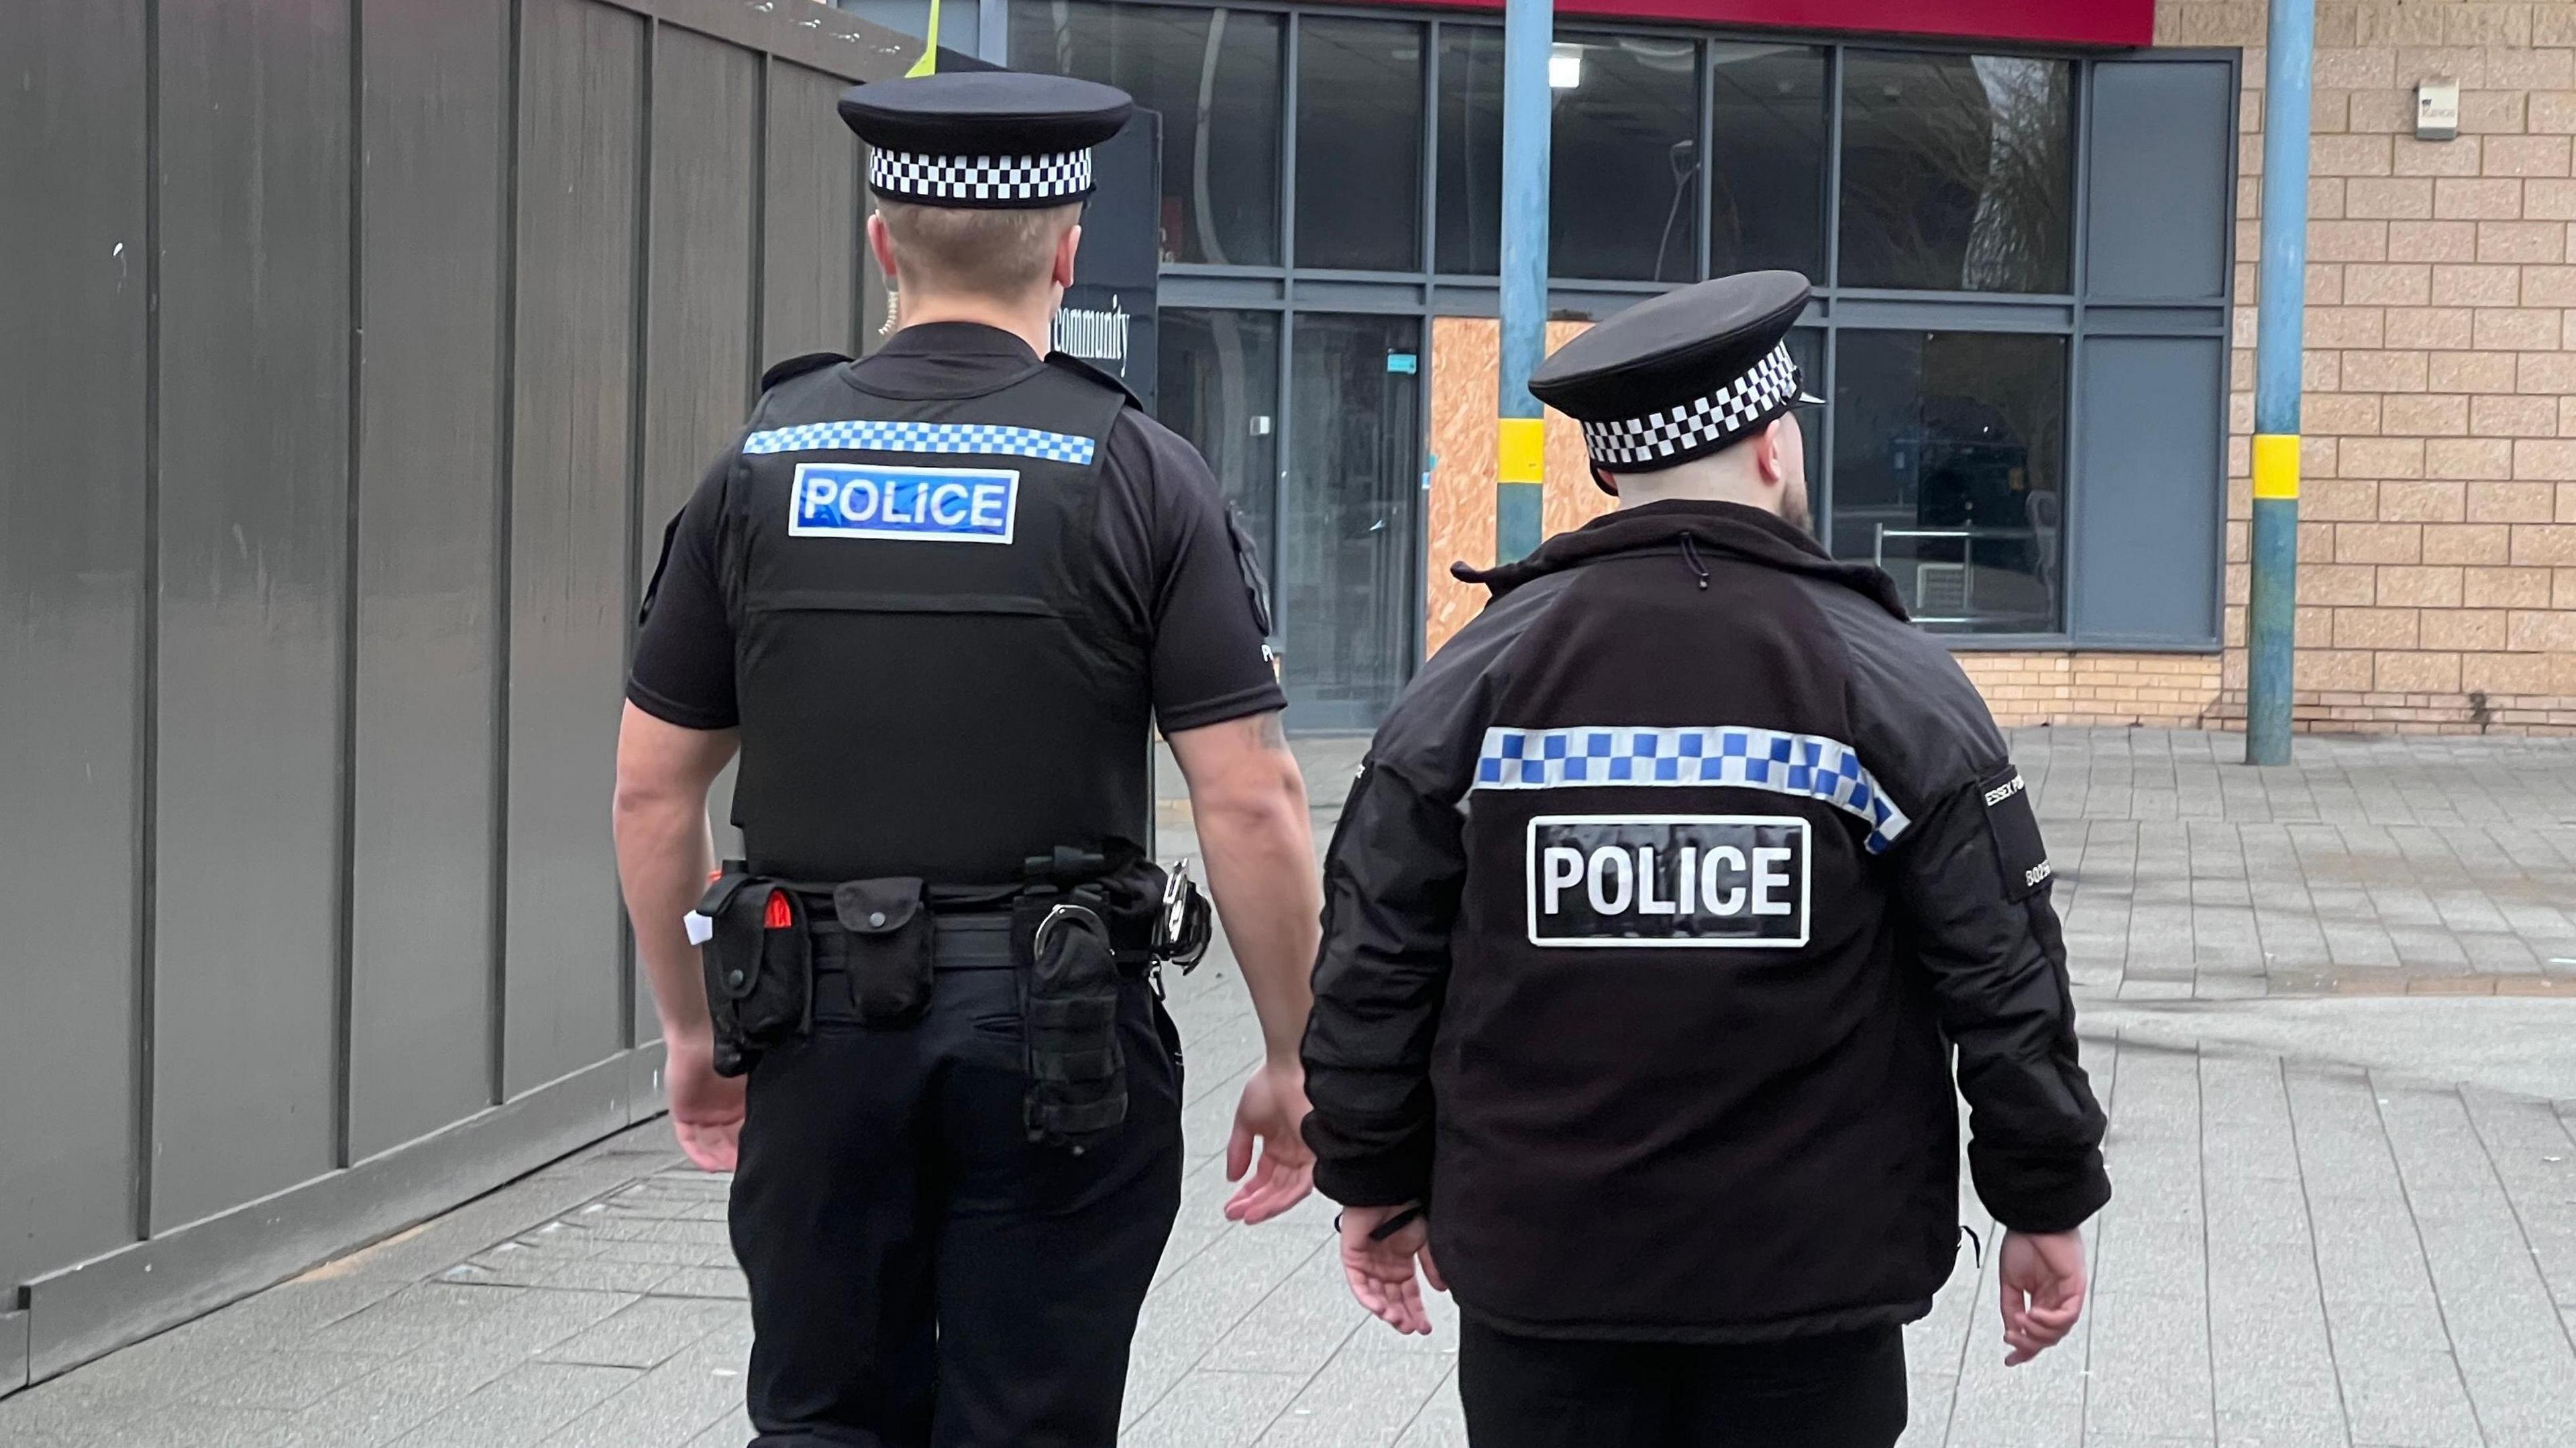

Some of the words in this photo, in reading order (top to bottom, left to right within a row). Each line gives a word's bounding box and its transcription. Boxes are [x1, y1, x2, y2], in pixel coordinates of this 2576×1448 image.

[1054, 294, 1130, 378] community
[804, 478, 1006, 526] POLICE
[1984, 781, 2015, 807] ESSEX
[1544, 845, 1792, 916] POLICE
